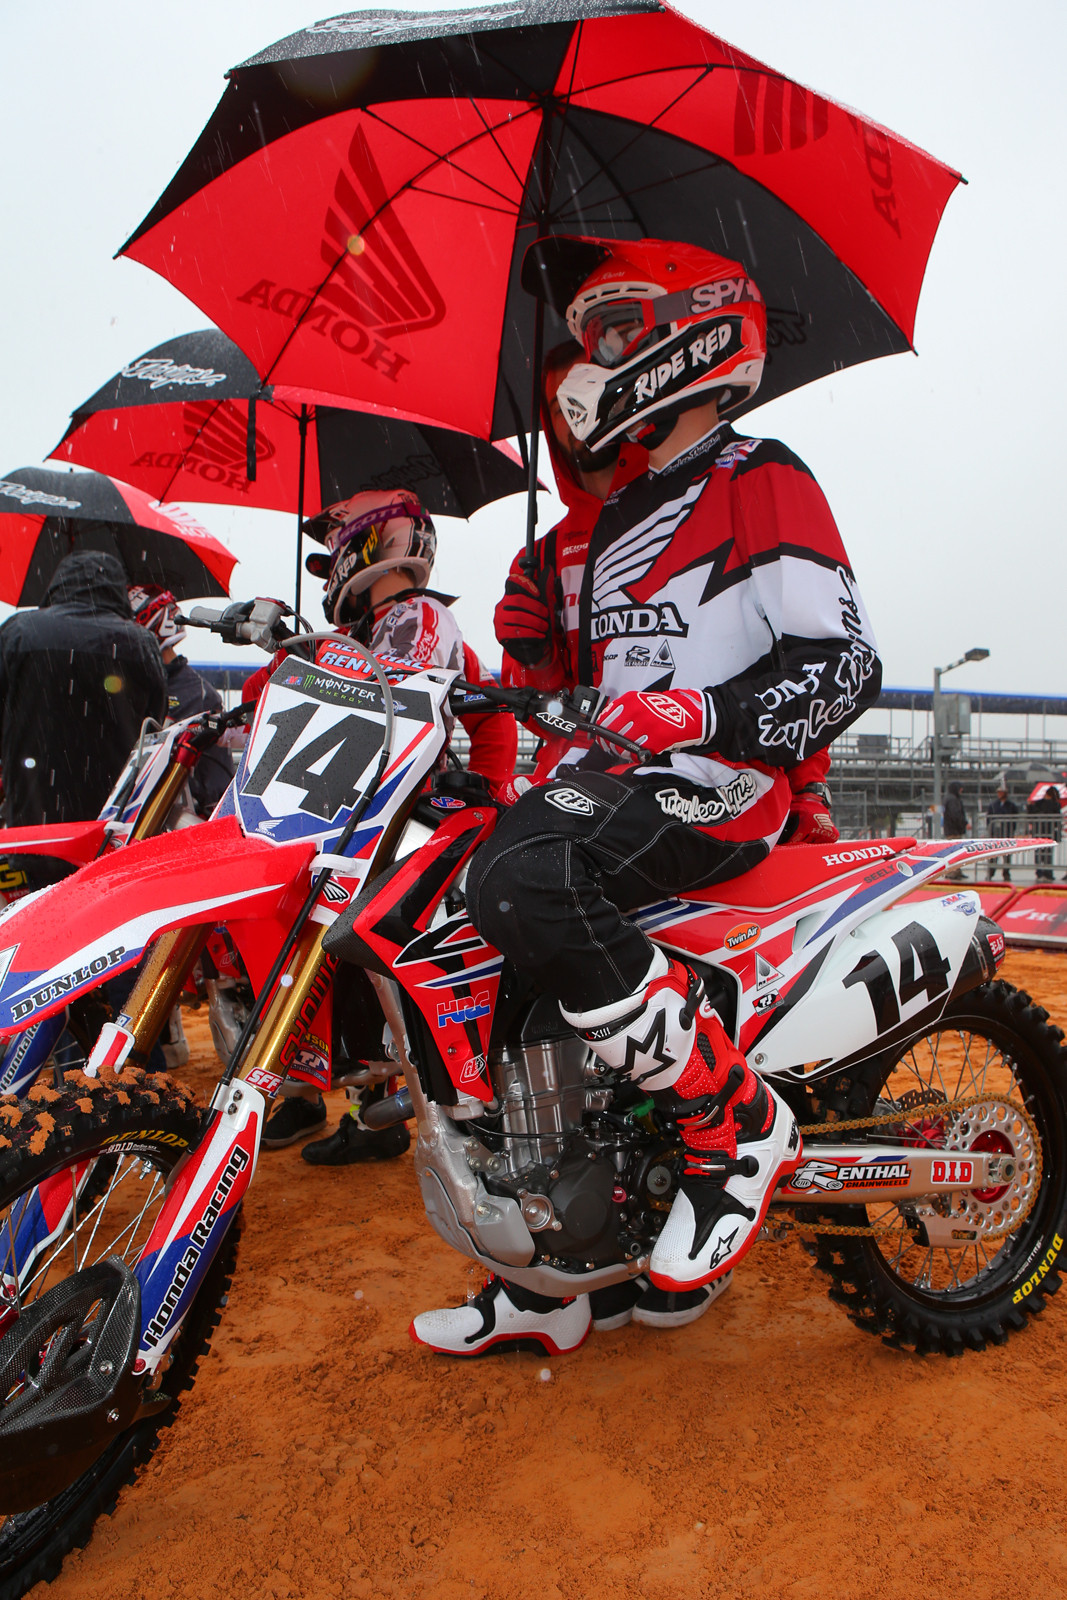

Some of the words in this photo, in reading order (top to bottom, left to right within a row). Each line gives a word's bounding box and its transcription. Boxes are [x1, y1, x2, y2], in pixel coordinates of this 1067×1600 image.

[632, 349, 685, 404] RIDE
[688, 322, 732, 365] RED
[319, 689, 363, 704] ENERGY
[536, 712, 577, 733] ARC
[241, 701, 387, 821] 14
[822, 844, 896, 867] HONDA
[964, 841, 1018, 854] DUNLOP
[863, 864, 895, 884] SEELY
[727, 933, 748, 948] Twin
[746, 925, 759, 940] Air
[11, 945, 126, 1023] DUNLOP
[841, 921, 951, 1036] 14
[436, 990, 491, 1029] HRC
[100, 1129, 189, 1148] DUNLOP
[790, 1160, 910, 1191] RENTHAL
[845, 1179, 909, 1188] CHAINWHEELS
[142, 1244, 202, 1348] Honda
[189, 1143, 250, 1249] Racing
[1012, 1232, 1064, 1304] DUNLOP
